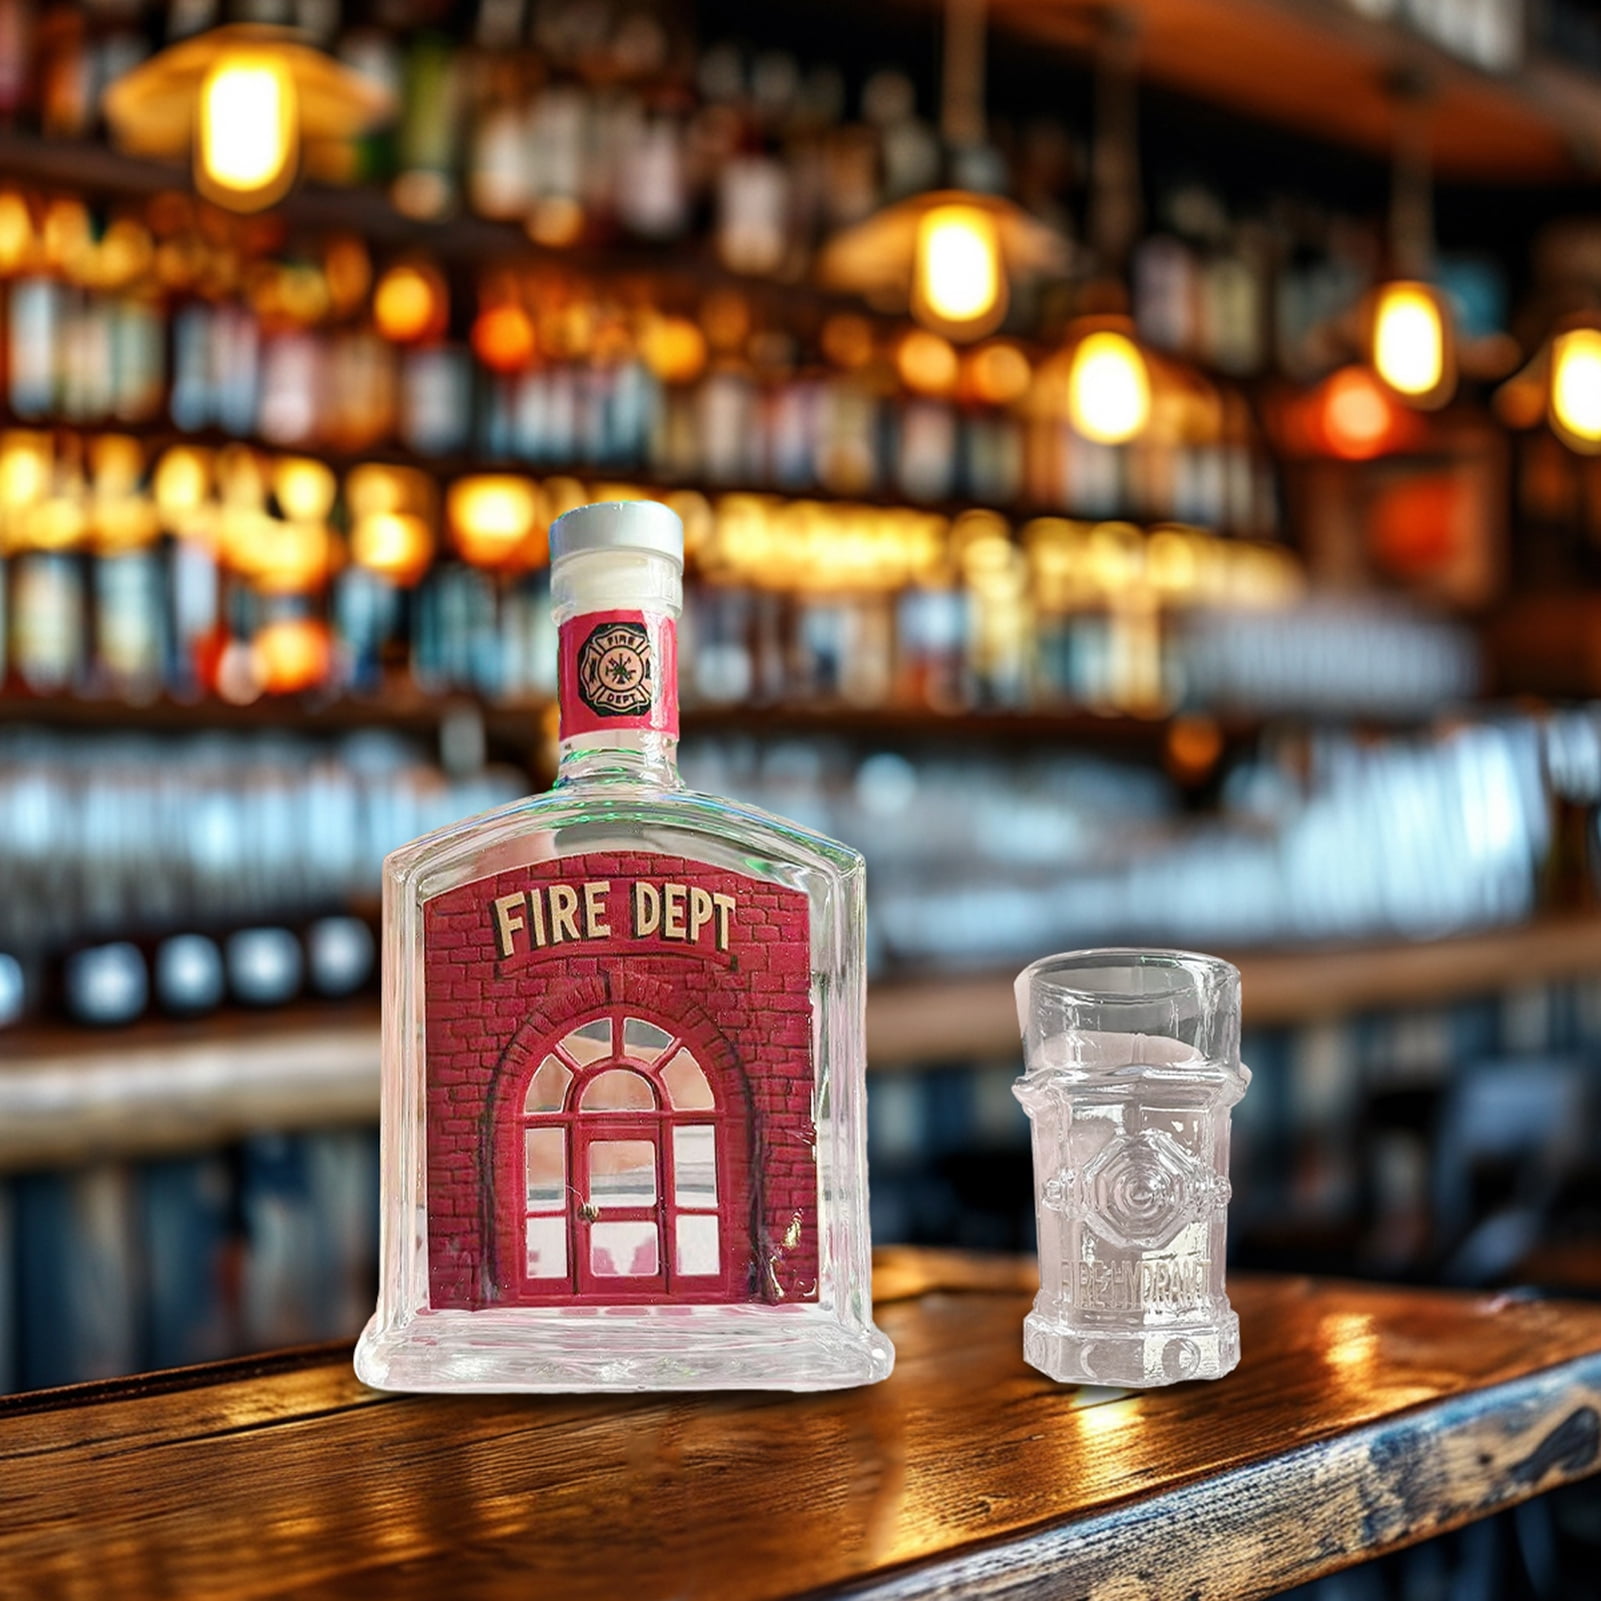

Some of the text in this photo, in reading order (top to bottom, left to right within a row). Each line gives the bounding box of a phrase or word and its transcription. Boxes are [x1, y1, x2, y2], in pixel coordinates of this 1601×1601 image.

[607, 634, 636, 646] FIRE
[607, 692, 636, 704] DEPT
[494, 880, 736, 957] FIRE DEPT
